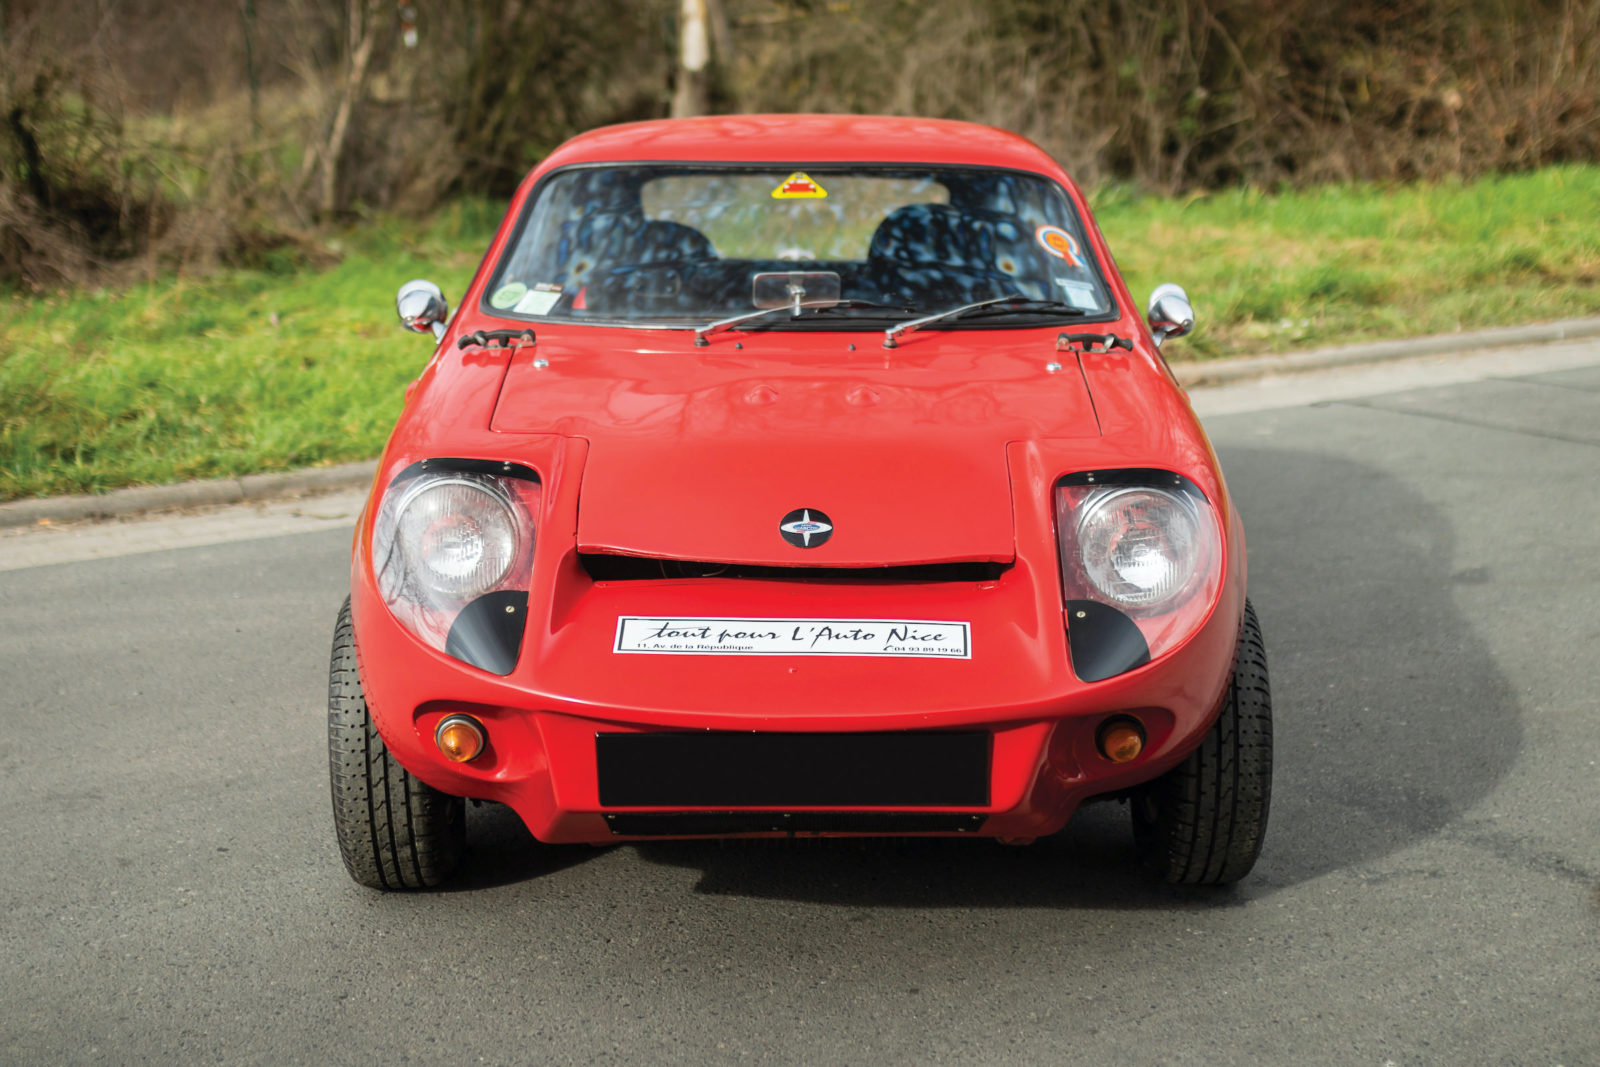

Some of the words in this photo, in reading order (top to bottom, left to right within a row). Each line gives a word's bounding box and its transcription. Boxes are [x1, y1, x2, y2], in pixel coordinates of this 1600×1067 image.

[642, 622, 711, 641] tout
[716, 629, 781, 643] pour
[792, 626, 874, 648] L'Auto
[886, 625, 946, 643] Nice
